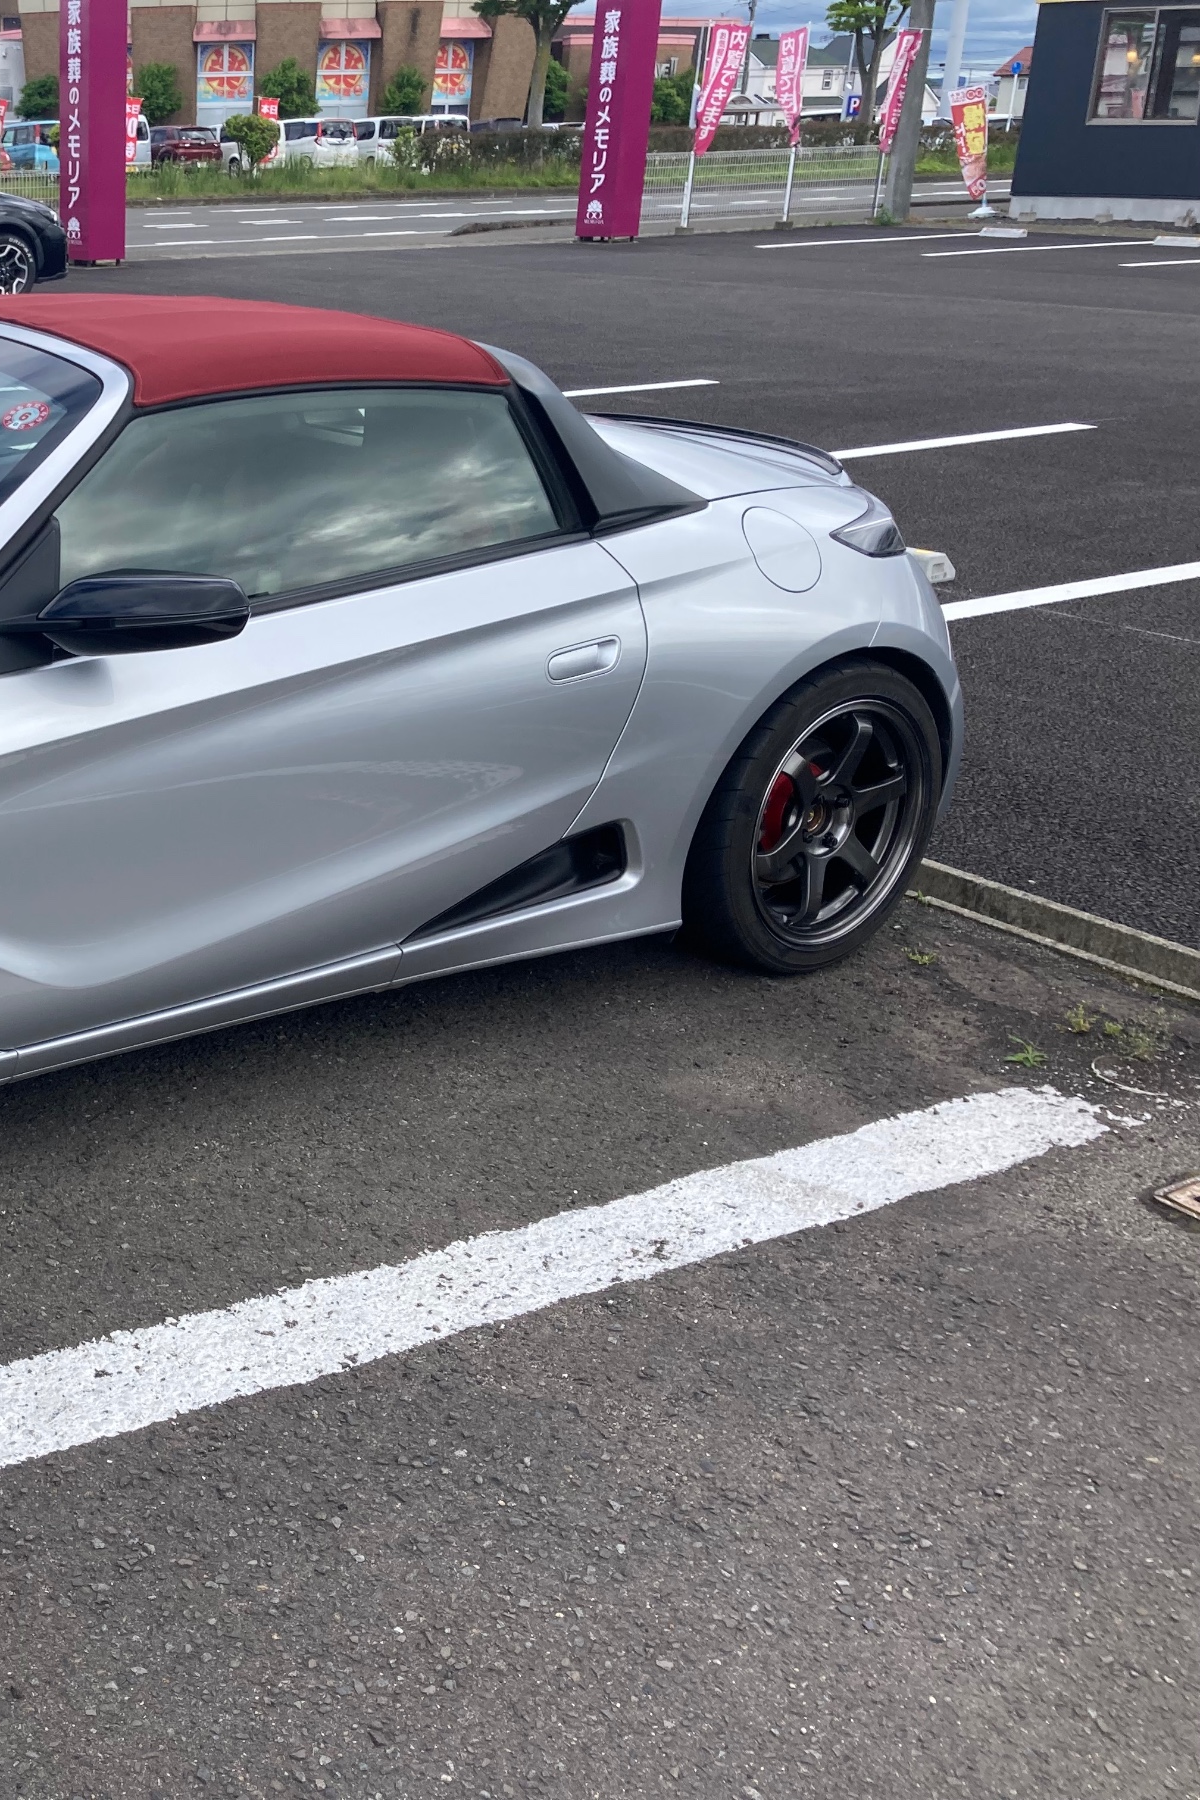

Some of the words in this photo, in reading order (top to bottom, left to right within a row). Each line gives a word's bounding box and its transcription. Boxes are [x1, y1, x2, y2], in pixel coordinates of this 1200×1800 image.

[67, 0, 82, 209] 家族葬のメモリア
[260, 104, 278, 115] 本日
[589, 9, 622, 194] 家族葬のメモリア
[699, 30, 748, 140] 内覧できます
[849, 97, 860, 114] P
